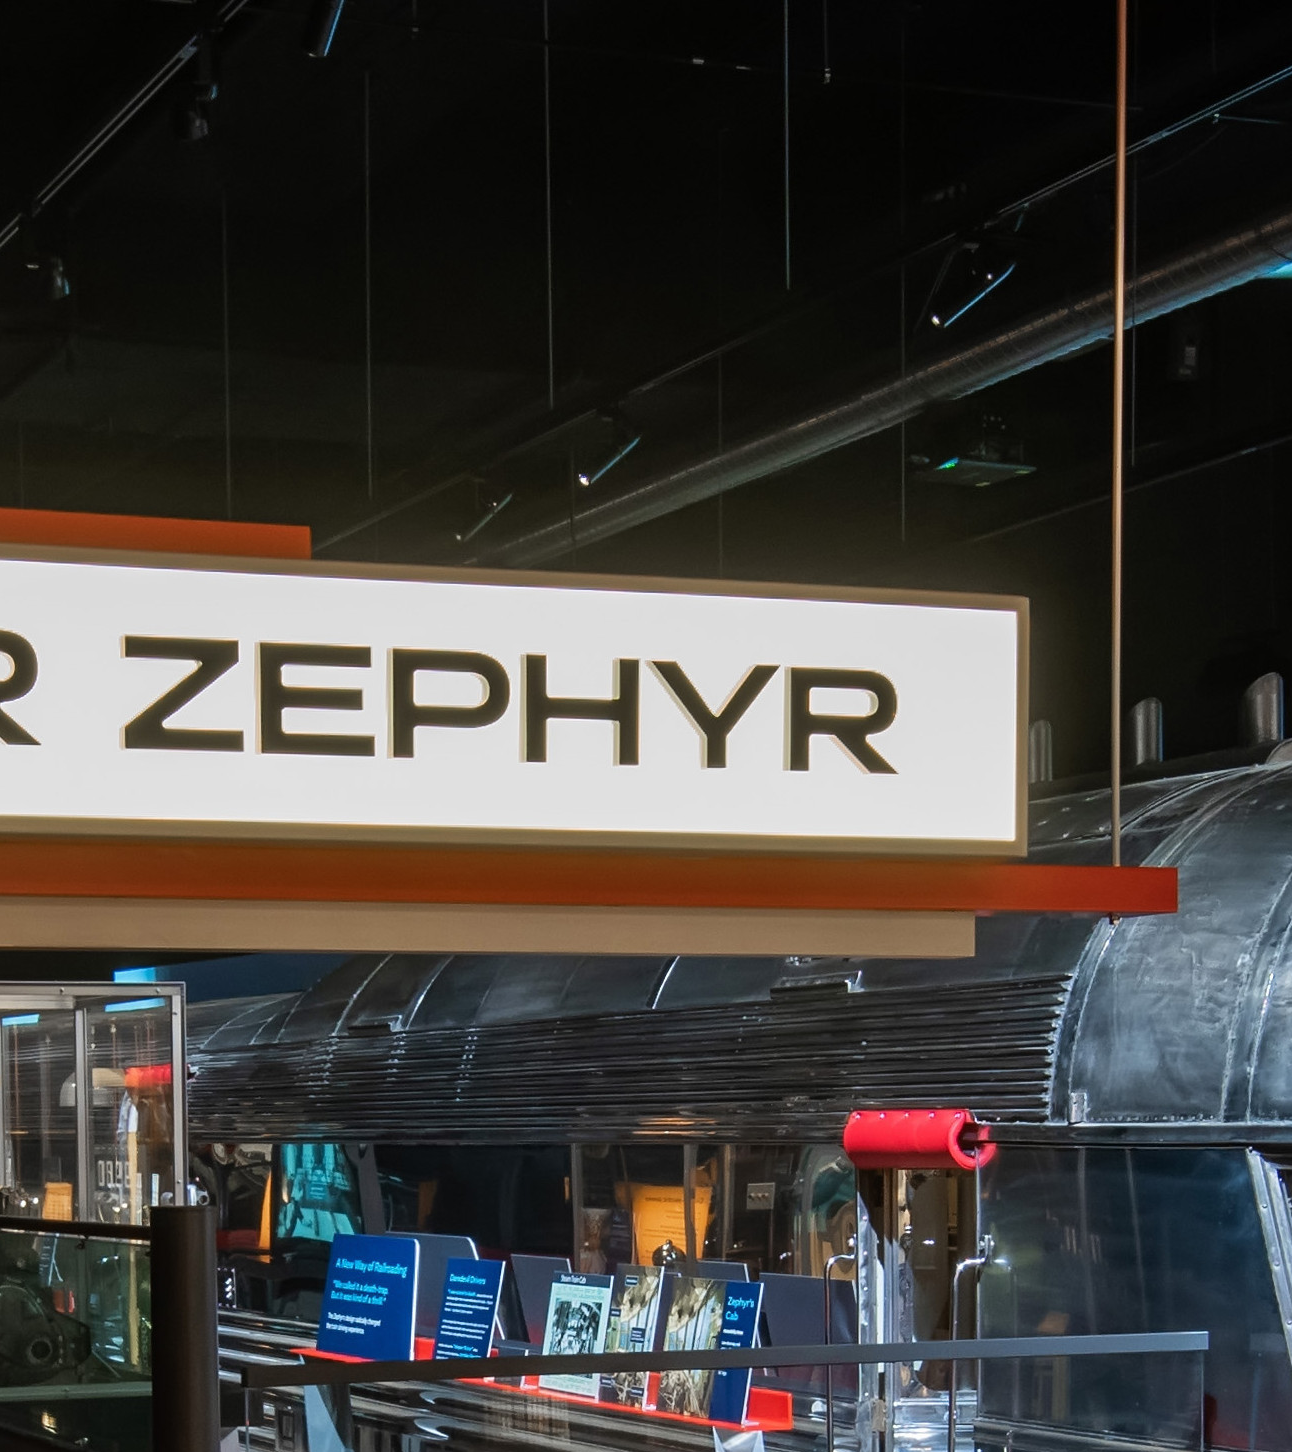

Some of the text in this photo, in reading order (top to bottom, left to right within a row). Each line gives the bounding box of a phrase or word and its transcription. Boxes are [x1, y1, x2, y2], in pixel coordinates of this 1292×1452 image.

[123, 635, 900, 777] ZEPHYR
[335, 1257, 408, 1278] A New Way of Railroading
[727, 1296, 755, 1309] Zephyr's
[725, 1310, 739, 1321] Cab
